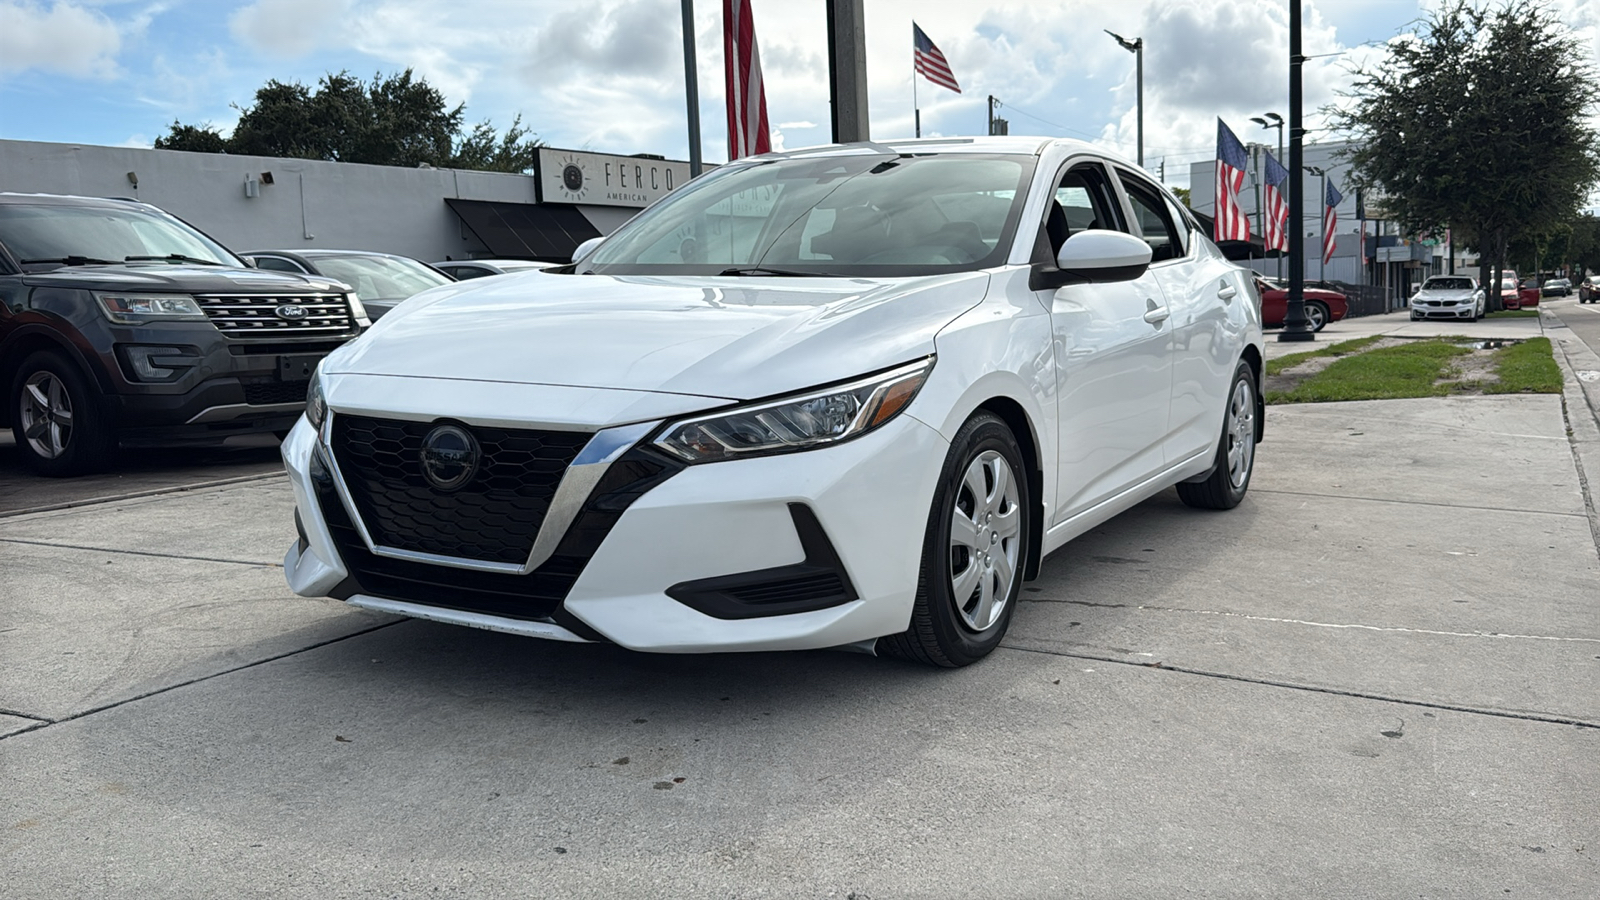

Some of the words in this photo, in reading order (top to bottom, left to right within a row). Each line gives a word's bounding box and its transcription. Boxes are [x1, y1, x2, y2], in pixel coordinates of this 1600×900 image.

[605, 163, 673, 191] FERCO
[606, 192, 648, 202] AMERICAN
[284, 306, 303, 316] Ford
